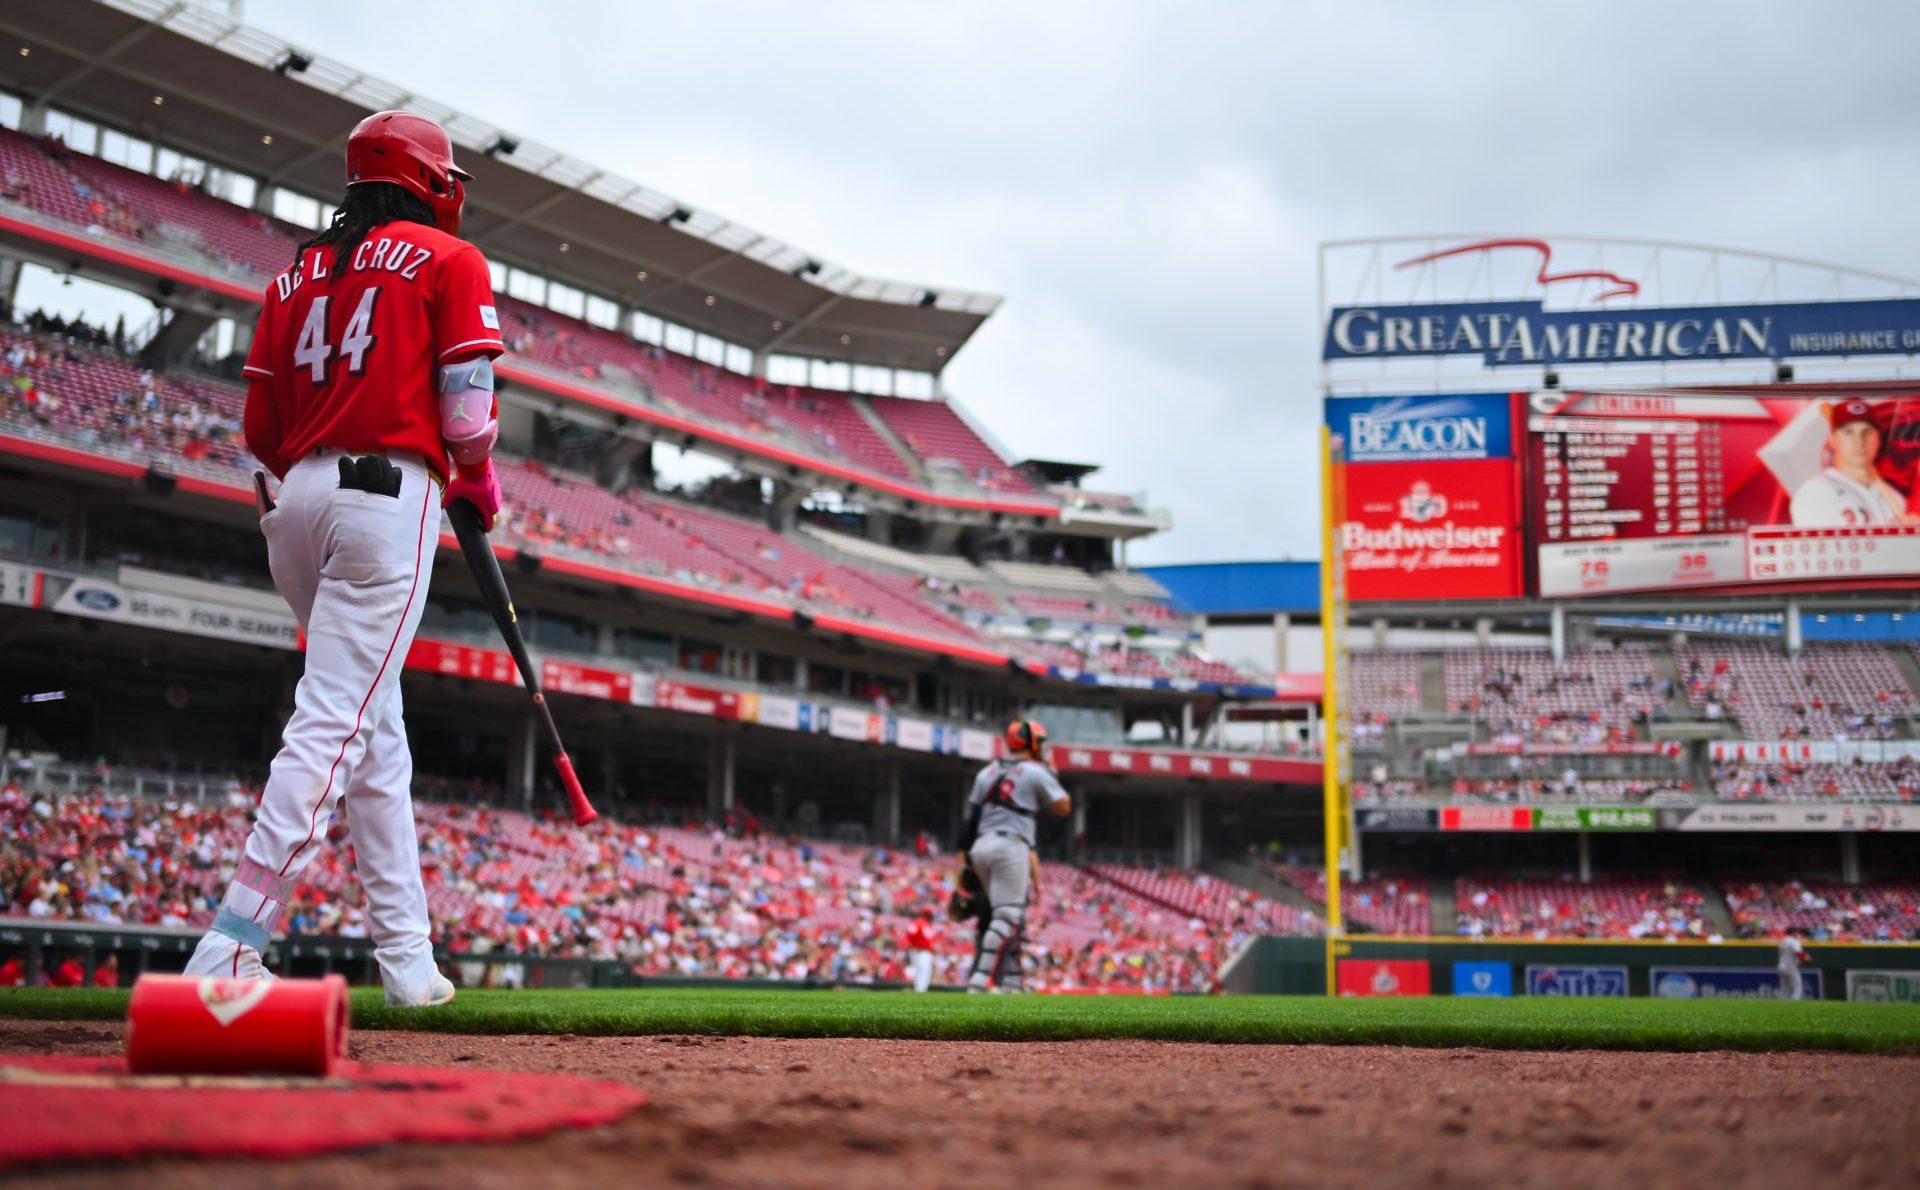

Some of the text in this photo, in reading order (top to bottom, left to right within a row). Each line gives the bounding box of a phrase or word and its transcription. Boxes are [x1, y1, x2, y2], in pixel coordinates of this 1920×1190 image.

[276, 238, 432, 303] DE L CRUZ
[293, 286, 381, 385] 44
[1333, 309, 1512, 354] GREAT
[1495, 315, 1774, 361] AMERICAN
[1789, 330, 1898, 352] INSURANCE
[1350, 413, 1487, 451] BEACON
[1342, 520, 1505, 550] Budweiser
